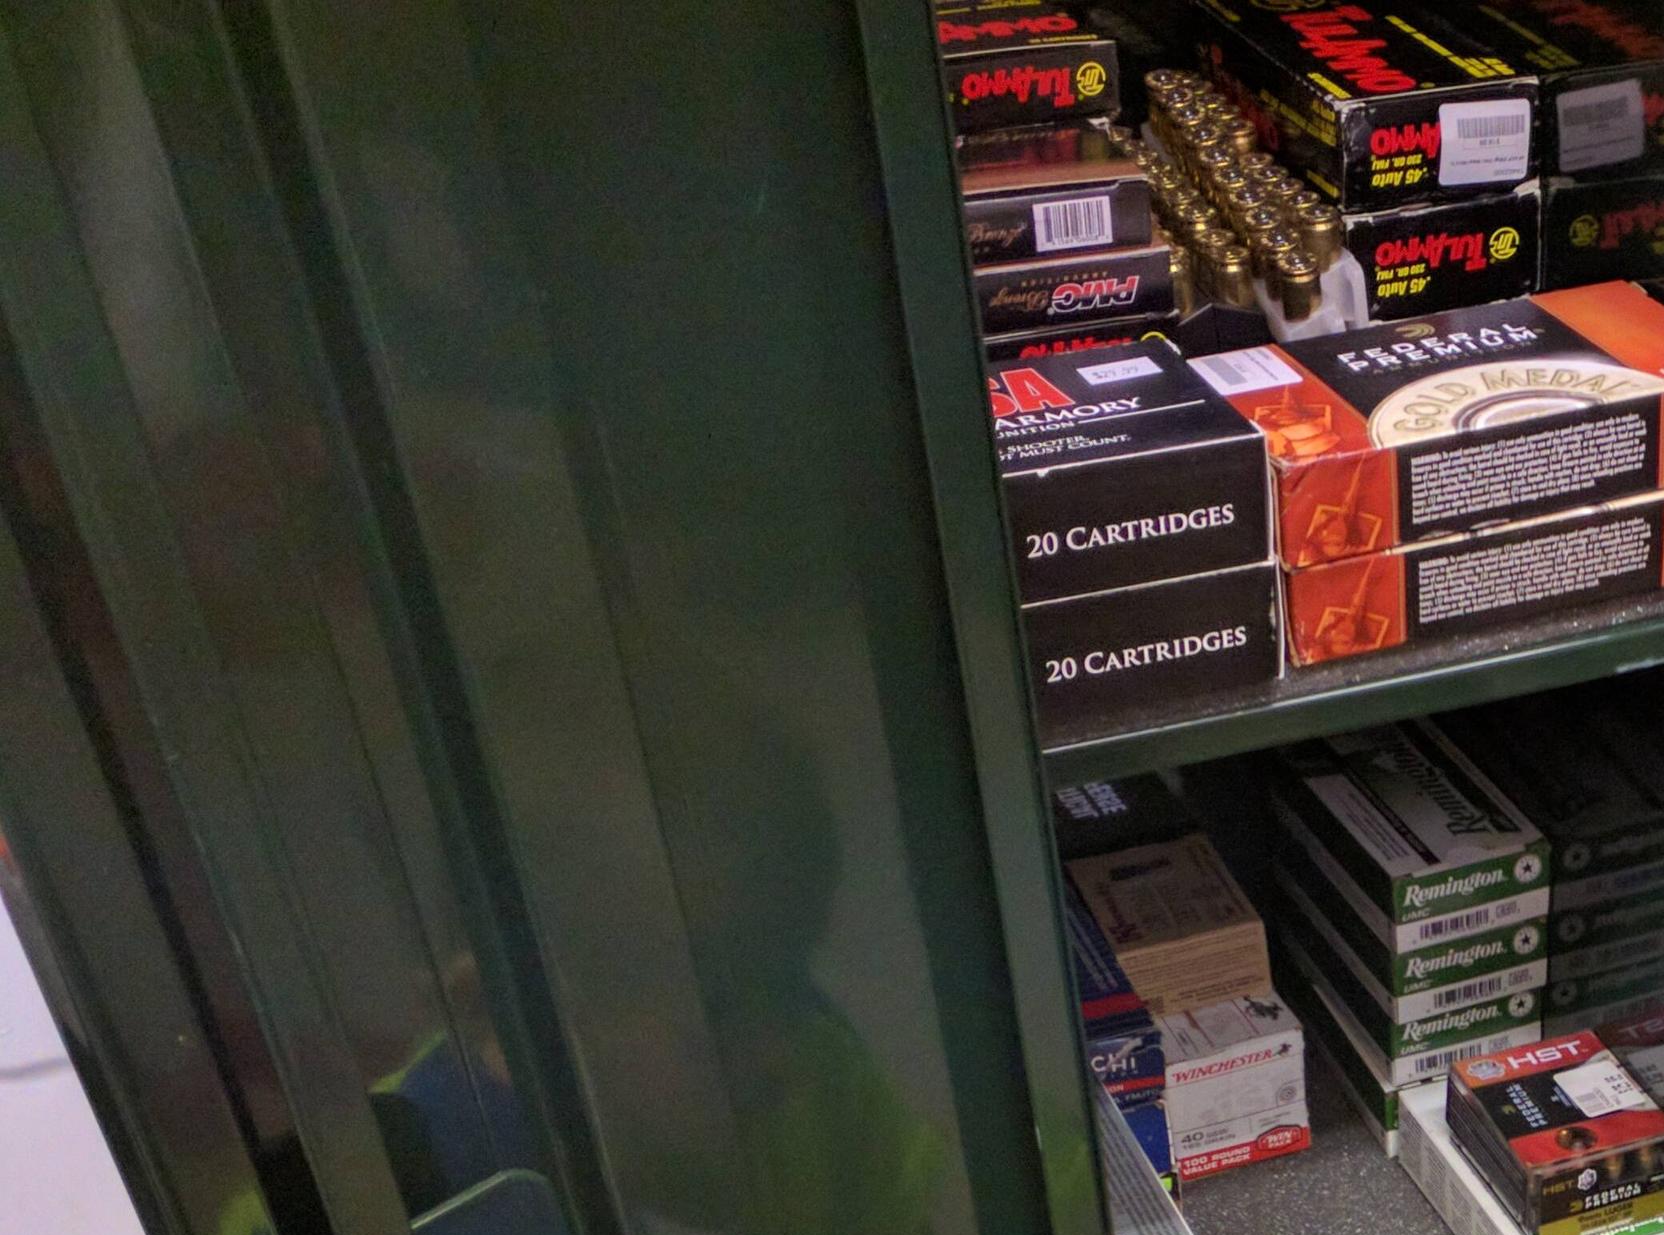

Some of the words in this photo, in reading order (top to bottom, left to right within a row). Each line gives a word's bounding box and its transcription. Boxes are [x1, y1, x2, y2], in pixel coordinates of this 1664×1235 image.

[1371, 170, 1404, 187] Auto
[1049, 274, 1140, 314] PMC
[1377, 280, 1408, 298] Auto
[1409, 276, 1431, 293] .45
[1337, 322, 1527, 366] FEDERAL
[1348, 327, 1539, 373] PREMIUM
[987, 367, 1076, 418] SA
[1393, 381, 1477, 433] GOLD
[1479, 366, 1637, 401] MEDAL
[994, 396, 1142, 432] ARMORY
[1026, 531, 1059, 559] 20
[1065, 503, 1236, 551] CARTRIDGES
[1046, 657, 1077, 684] 20
[1084, 626, 1247, 674] CARTRIDGES
[1403, 869, 1504, 908] Remington
[1404, 941, 1502, 979] Remington
[1402, 1004, 1499, 1041] Remington
[1171, 1048, 1273, 1084] WINCHESTER
[1507, 1039, 1583, 1070] HST
[1181, 1131, 1205, 1143] 40
[1183, 1156, 1208, 1169] 100
